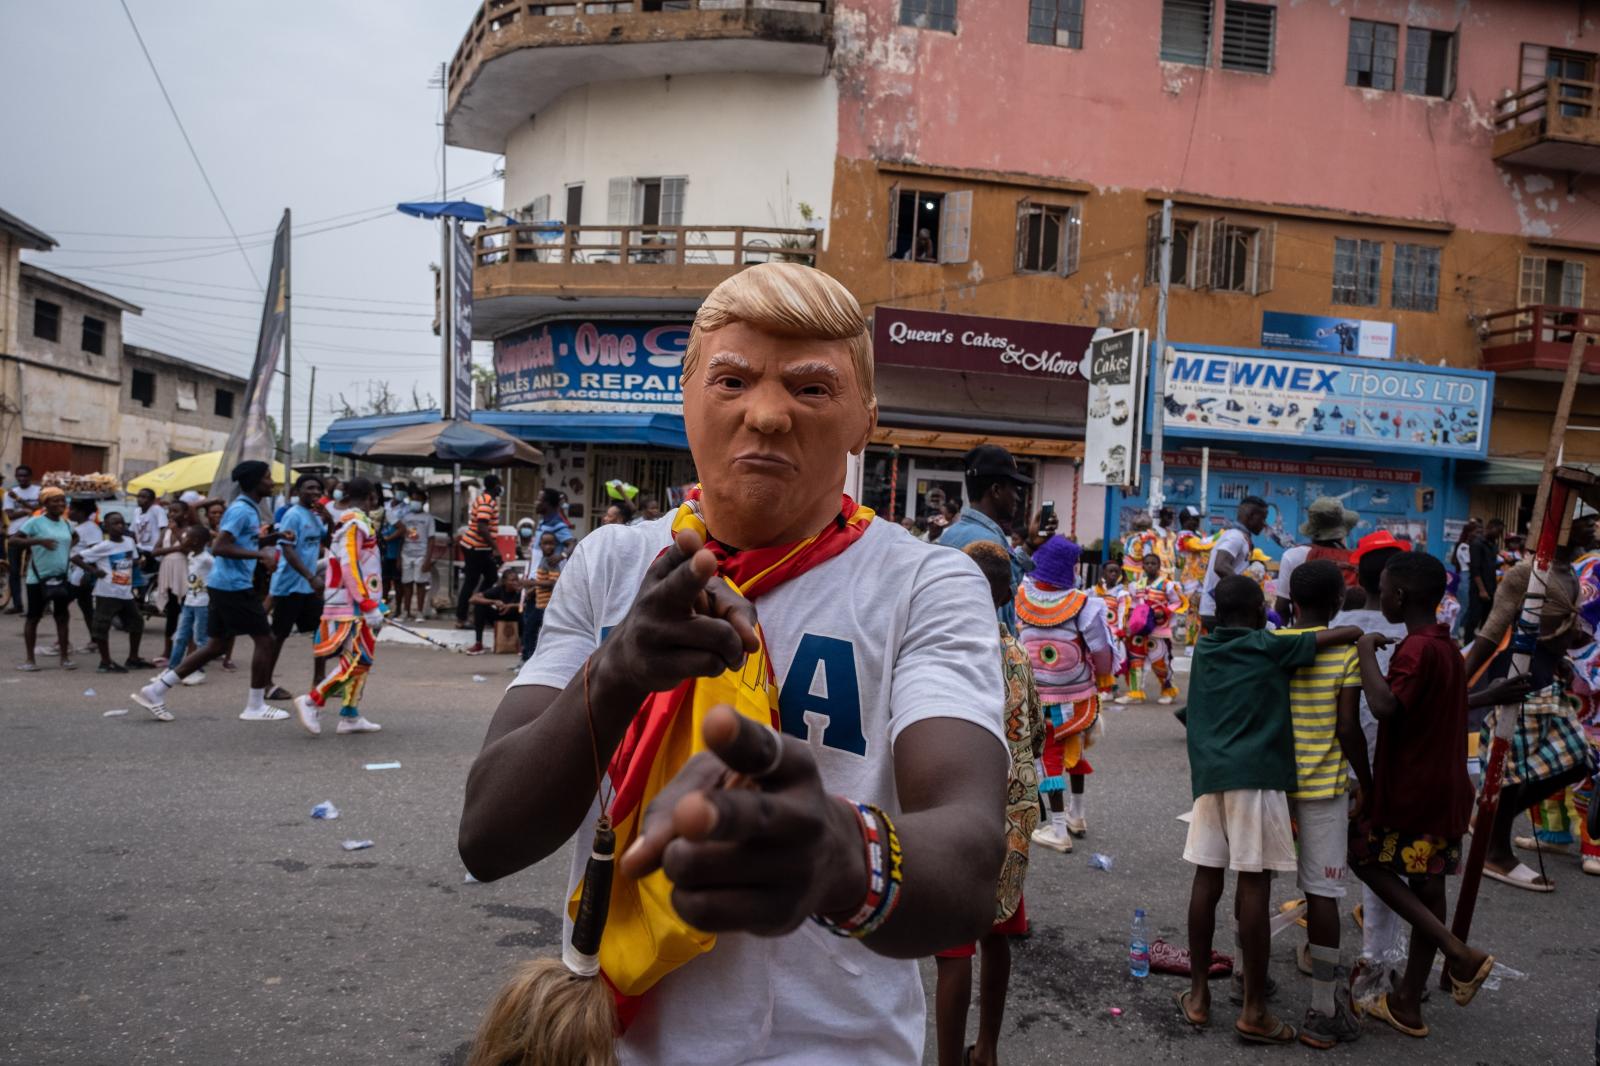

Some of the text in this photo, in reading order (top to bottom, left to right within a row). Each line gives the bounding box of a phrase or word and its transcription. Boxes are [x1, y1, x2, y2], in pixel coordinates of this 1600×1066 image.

[575, 322, 637, 368] One
[889, 322, 954, 344] Queen's
[961, 331, 1008, 349] Cakes
[1022, 350, 1079, 376] More
[1094, 355, 1129, 375] Cakes
[1172, 357, 1340, 392] MEWNEX
[1350, 373, 1425, 399] TOOLS
[1433, 381, 1475, 403] LTD
[532, 373, 569, 390] AND
[580, 373, 683, 391] REPAI
[566, 390, 683, 402] ACCESSORIES
